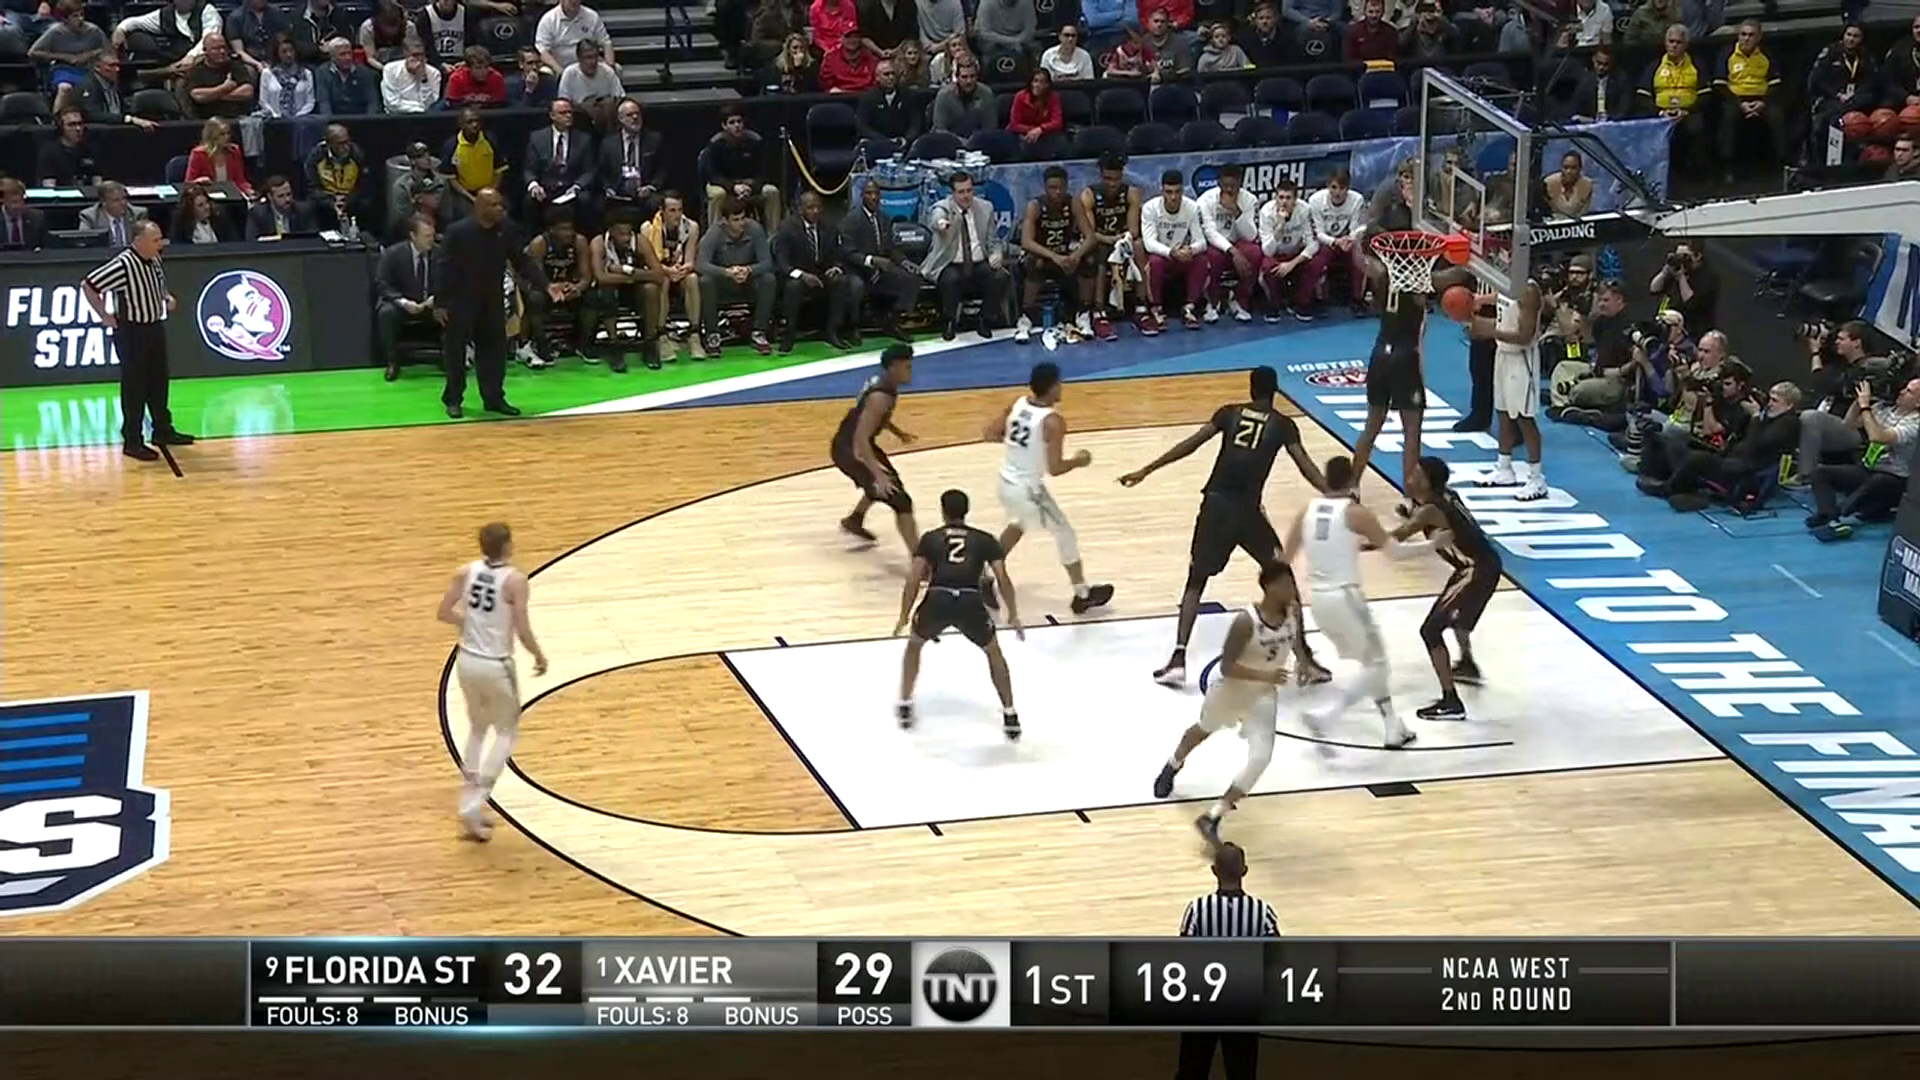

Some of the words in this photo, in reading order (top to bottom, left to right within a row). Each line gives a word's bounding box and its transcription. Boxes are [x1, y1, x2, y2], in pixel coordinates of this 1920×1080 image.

[1242, 162, 1305, 192] ARCH
[1046, 230, 1065, 247] 25
[1529, 222, 1595, 246] SPALDING
[7, 286, 167, 327] FLORI
[34, 326, 121, 368] STA
[1287, 360, 1365, 373] HOSTED
[1010, 420, 1031, 448] 22
[1234, 420, 1264, 449] 21
[948, 537, 966, 563] 2
[468, 583, 496, 613] 55
[1545, 567, 1729, 622] TO
[1626, 633, 1863, 717] THE
[1738, 731, 1920, 873] FIN
